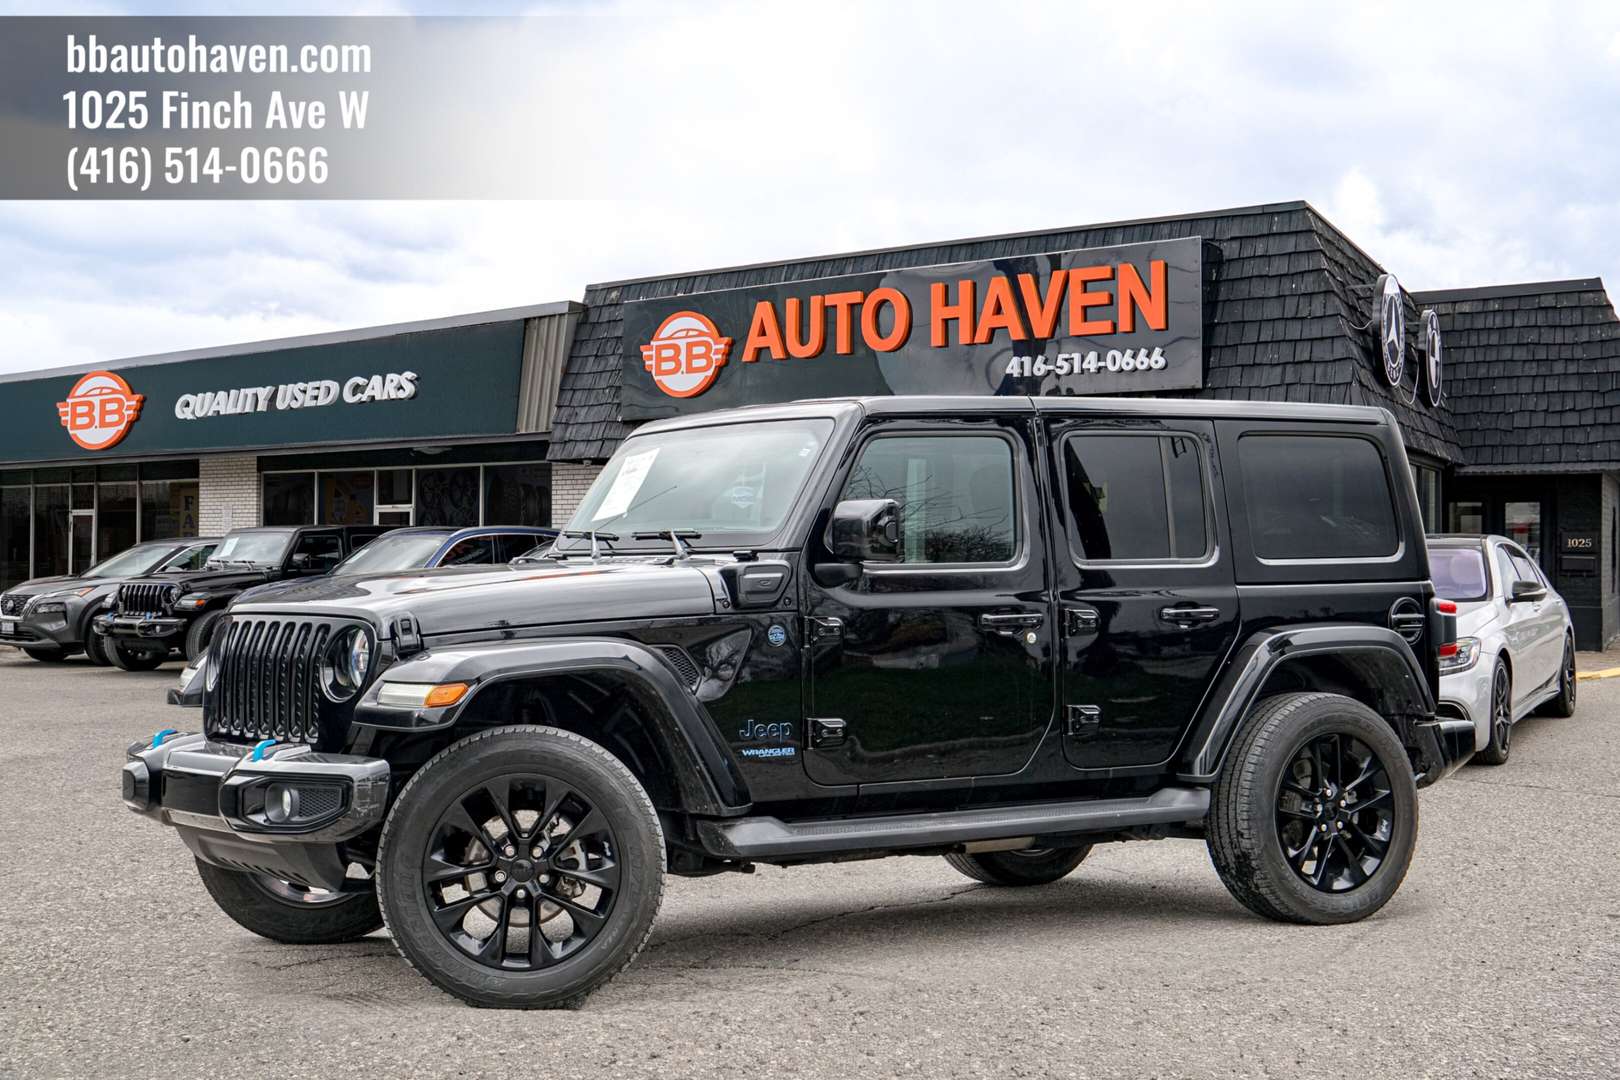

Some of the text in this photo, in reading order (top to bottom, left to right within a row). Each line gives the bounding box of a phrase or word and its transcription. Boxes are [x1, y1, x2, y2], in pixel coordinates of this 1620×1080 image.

[742, 260, 1169, 362] AUTO HAVEN
[1005, 346, 1167, 378] 416-514-0666
[175, 370, 418, 420] QUALITY USED CARS
[1567, 538, 1592, 548] 1025
[739, 719, 793, 743] Jeep
